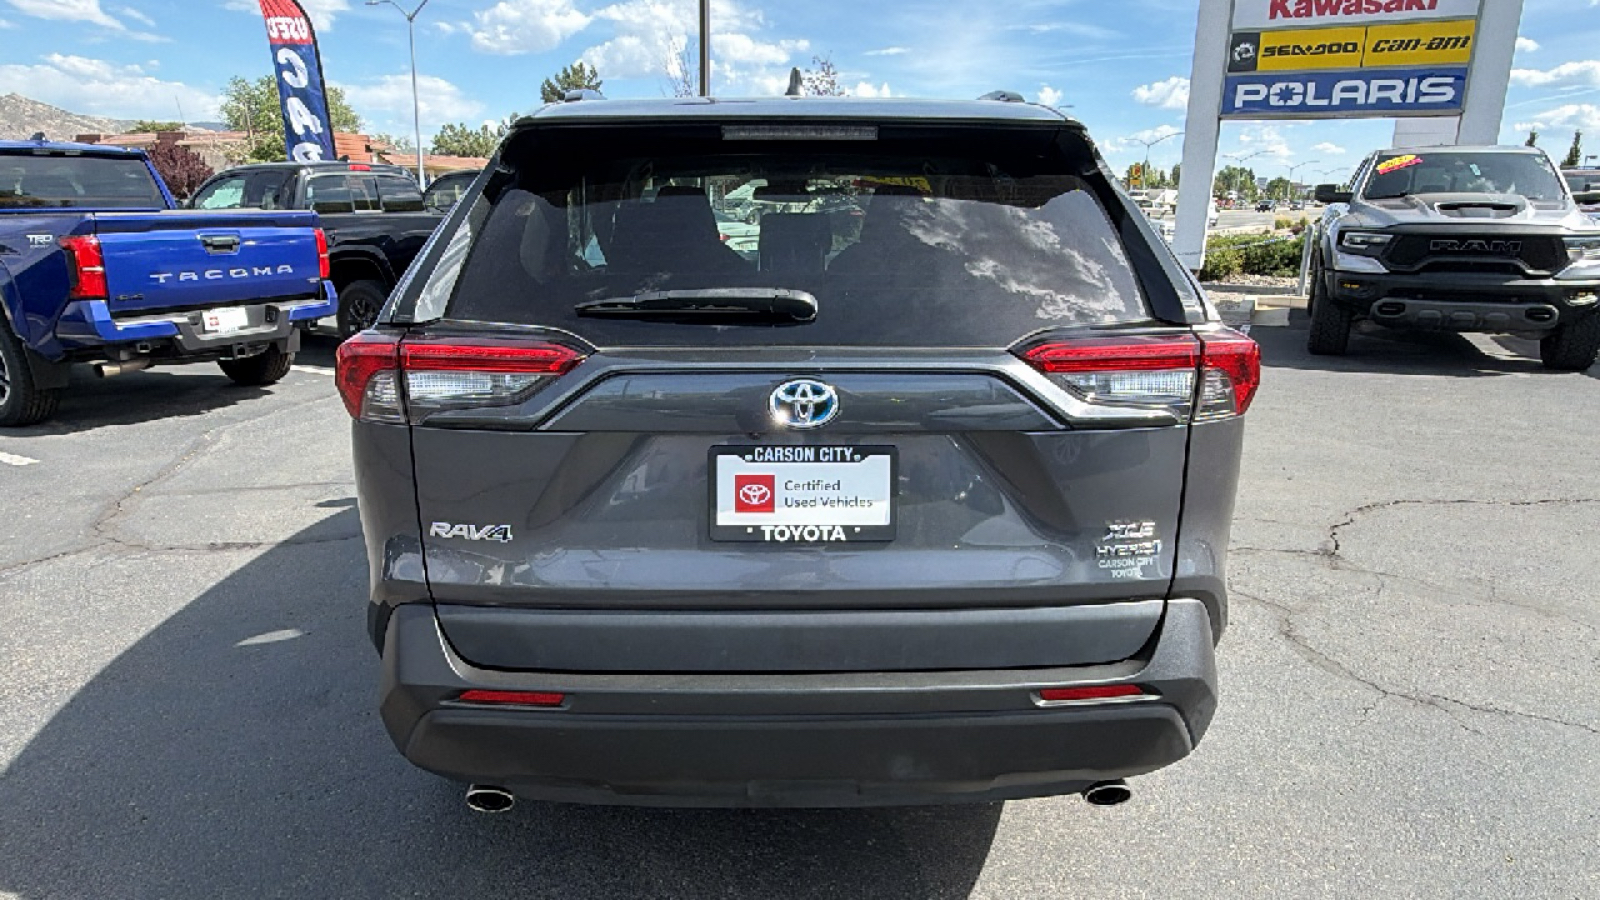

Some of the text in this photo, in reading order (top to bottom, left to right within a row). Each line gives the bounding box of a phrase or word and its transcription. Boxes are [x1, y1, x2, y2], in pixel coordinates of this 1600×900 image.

[1234, 77, 1456, 108] POLARIS
[1429, 240, 1522, 251] RAM
[150, 264, 294, 283] TACOMA
[754, 446, 854, 462] CARSON CITY
[784, 480, 841, 491] Certified
[784, 495, 874, 508] Used Vehicles
[429, 521, 514, 543] RAV4
[760, 525, 847, 541] TOYOTA
[1098, 558, 1135, 569] CARSON
[1110, 567, 1144, 578] TOYOTA
